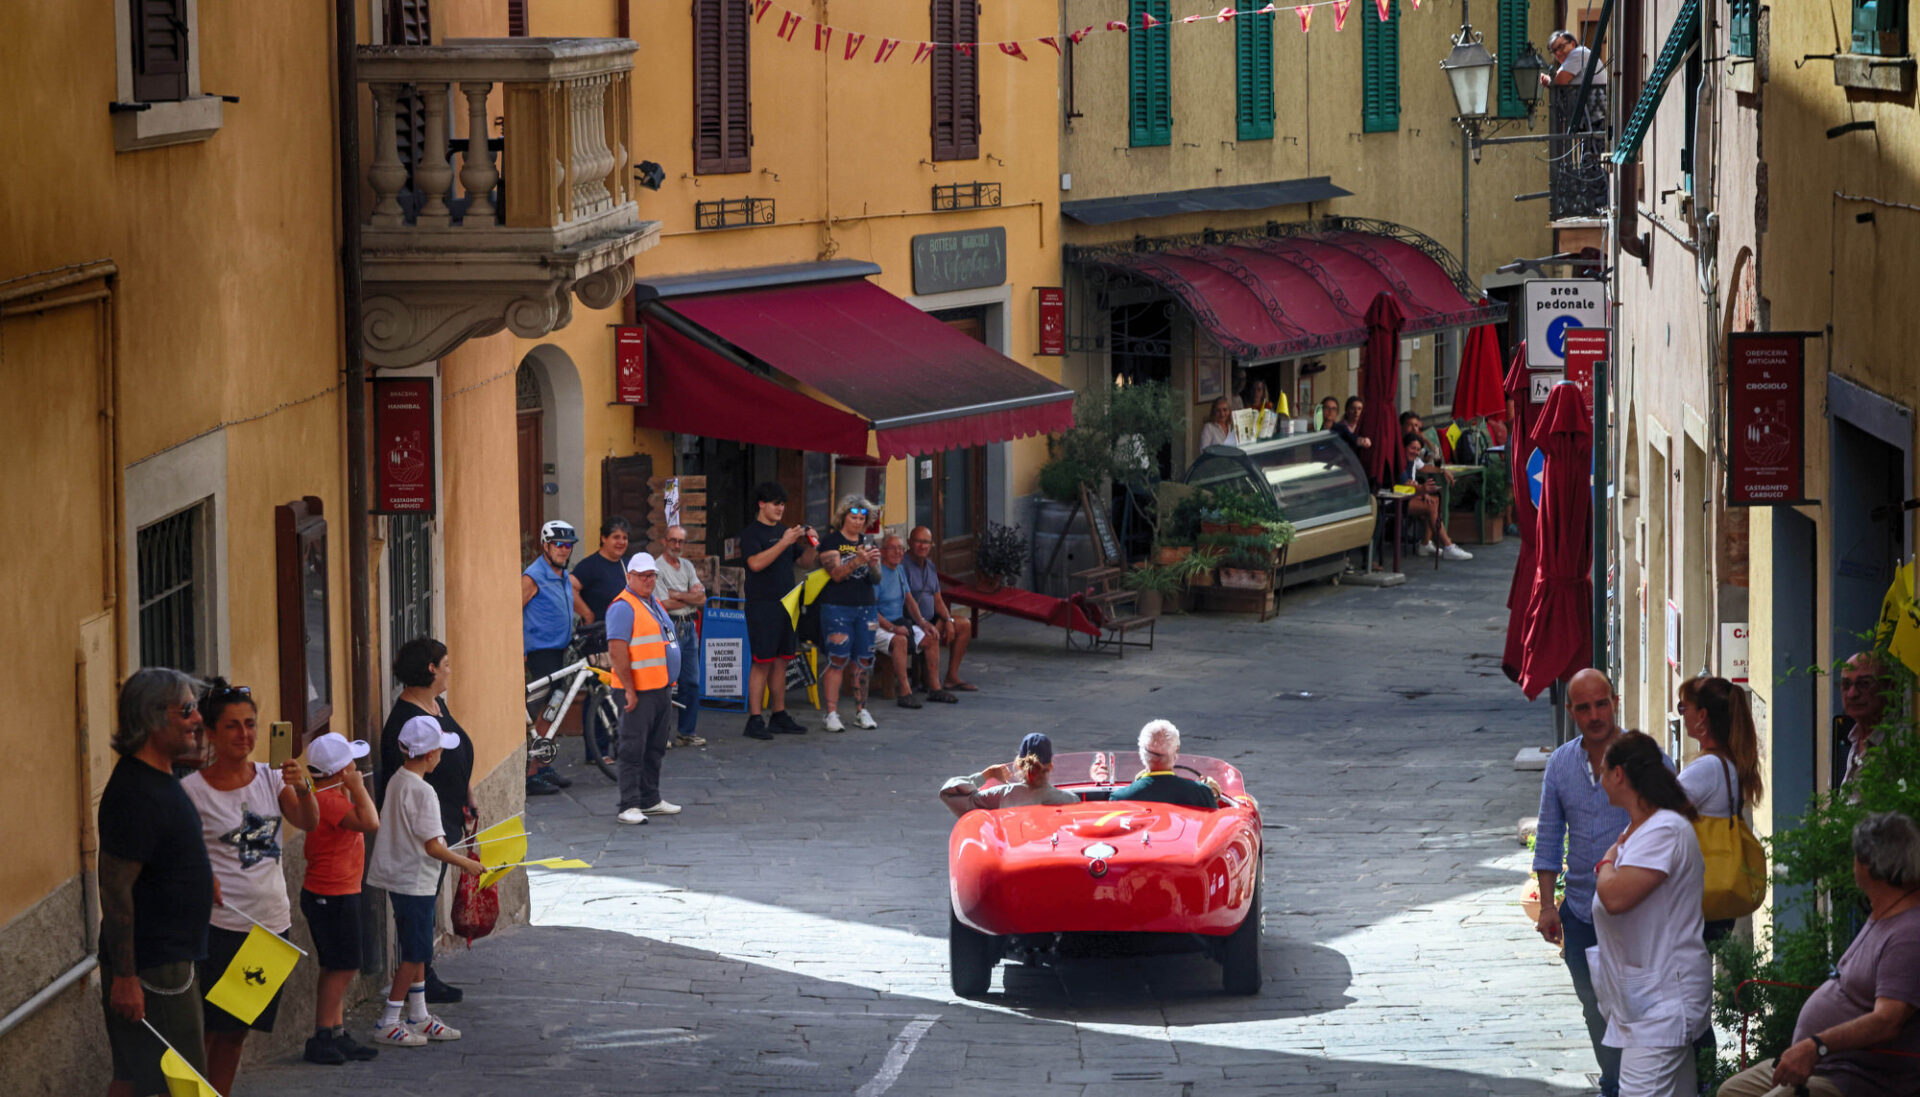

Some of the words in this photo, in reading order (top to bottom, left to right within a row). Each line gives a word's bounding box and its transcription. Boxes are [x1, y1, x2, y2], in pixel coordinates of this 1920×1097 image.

[1551, 287, 1579, 295] area
[1537, 299, 1595, 311] pedonale
[1763, 371, 1771, 379] IL
[1746, 382, 1788, 390] CROGIOLO
[720, 611, 745, 619] NAZION
